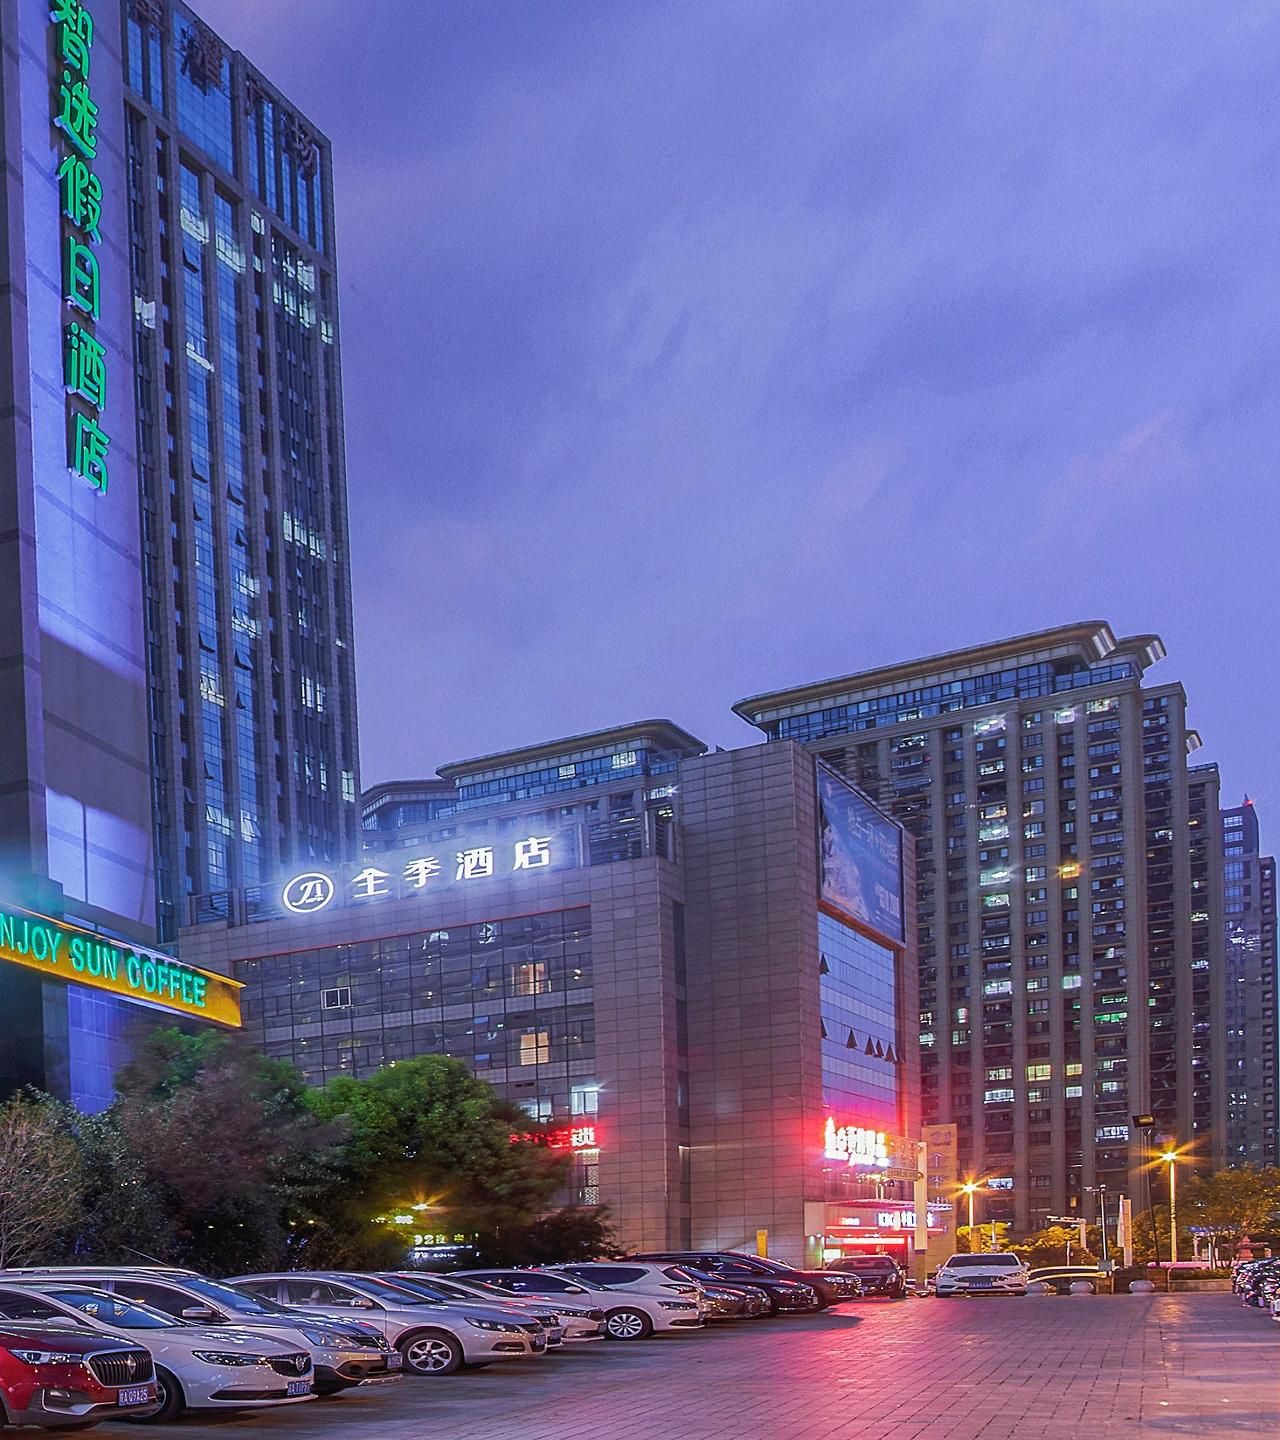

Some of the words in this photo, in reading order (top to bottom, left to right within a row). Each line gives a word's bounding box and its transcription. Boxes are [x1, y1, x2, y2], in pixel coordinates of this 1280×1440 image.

[350, 836, 552, 899] 全季酒店
[68, 936, 118, 981] SUN
[126, 952, 207, 1008] COFFEE
